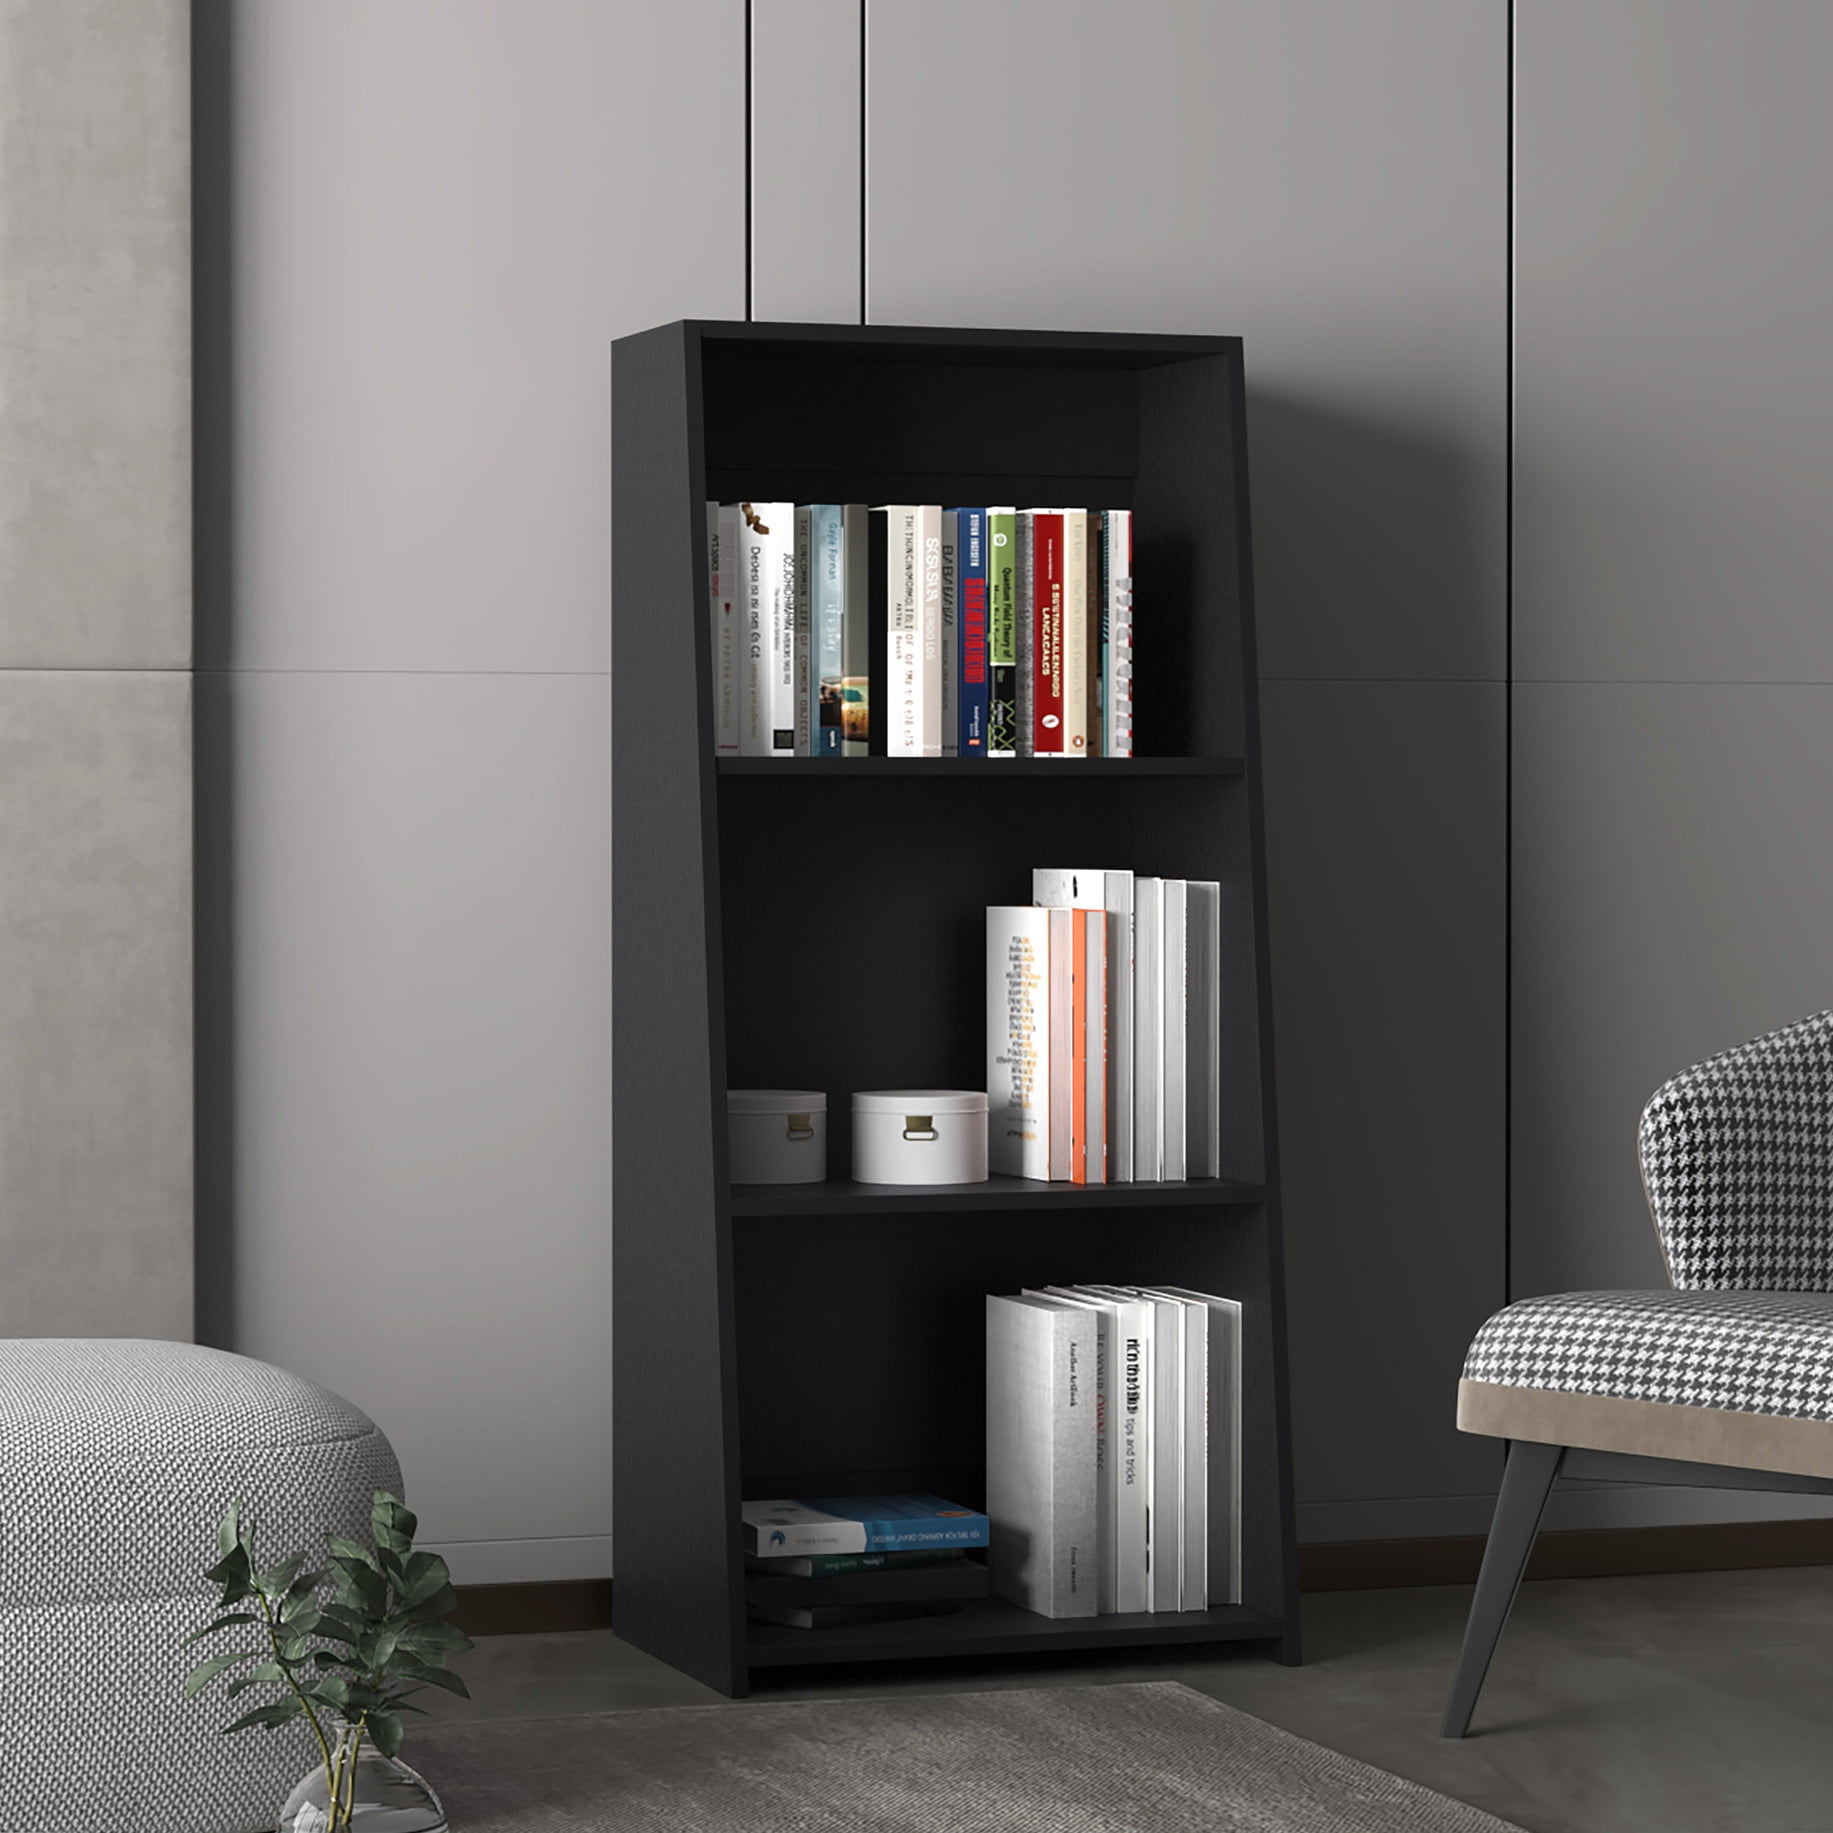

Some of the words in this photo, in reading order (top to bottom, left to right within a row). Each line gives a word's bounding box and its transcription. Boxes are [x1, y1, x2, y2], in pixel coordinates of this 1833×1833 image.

[799, 519, 808, 537] THE
[827, 522, 839, 546] Gayle
[799, 543, 808, 596] UNCOMMON
[828, 548, 838, 581] Forman
[1001, 566, 1013, 602] Quantum
[799, 602, 808, 628] LIFE
[1002, 603, 1013, 622] Field
[799, 634, 808, 647] OF
[1000, 622, 1013, 649] Theory
[1003, 649, 1013, 659] of
[799, 654, 808, 694] COMMON
[799, 699, 808, 746] OBJECTS
[1069, 1340, 1078, 1373] Another
[1096, 1392, 1106, 1434] OWN
[1125, 1417, 1137, 1436] tips
[1126, 1438, 1137, 1456] and
[1126, 1458, 1137, 1485] tricks
